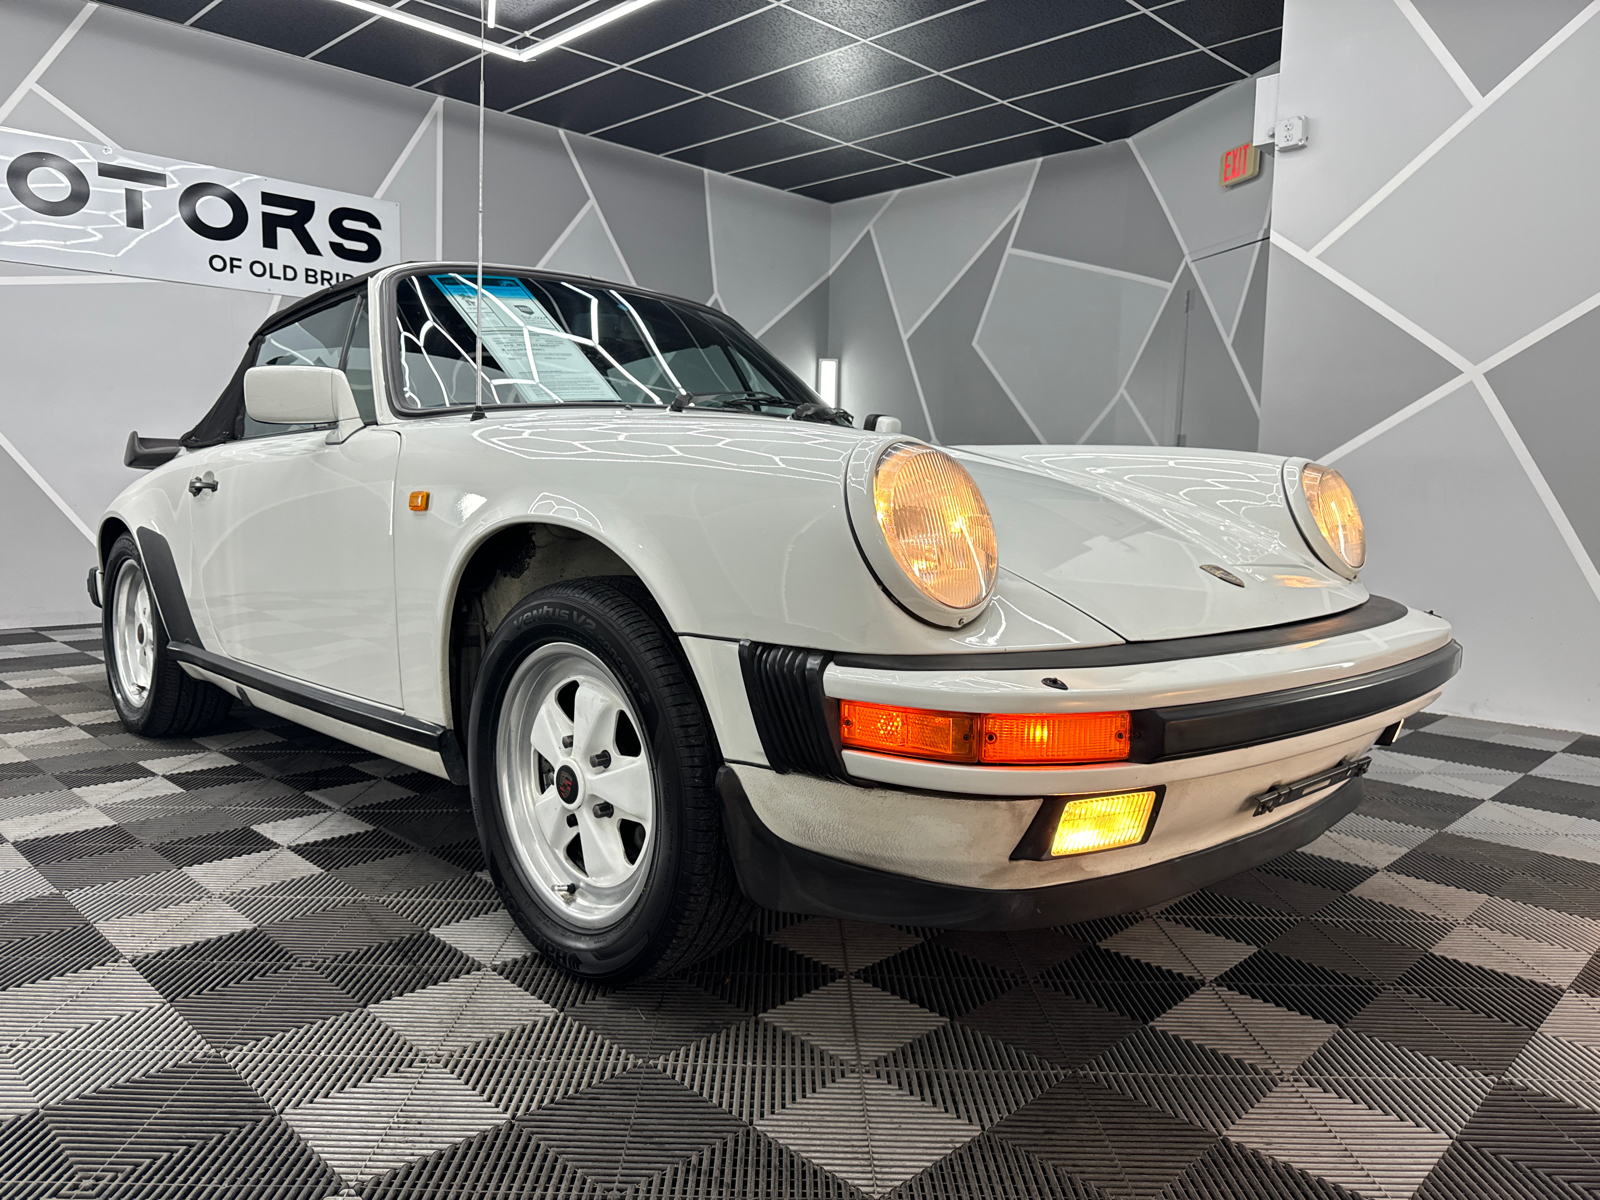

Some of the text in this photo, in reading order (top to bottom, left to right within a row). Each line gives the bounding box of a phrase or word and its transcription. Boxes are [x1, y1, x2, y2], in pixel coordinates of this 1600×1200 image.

[1223, 143, 1250, 182] EXIT
[208, 254, 242, 274] OF
[248, 260, 298, 281] OLD
